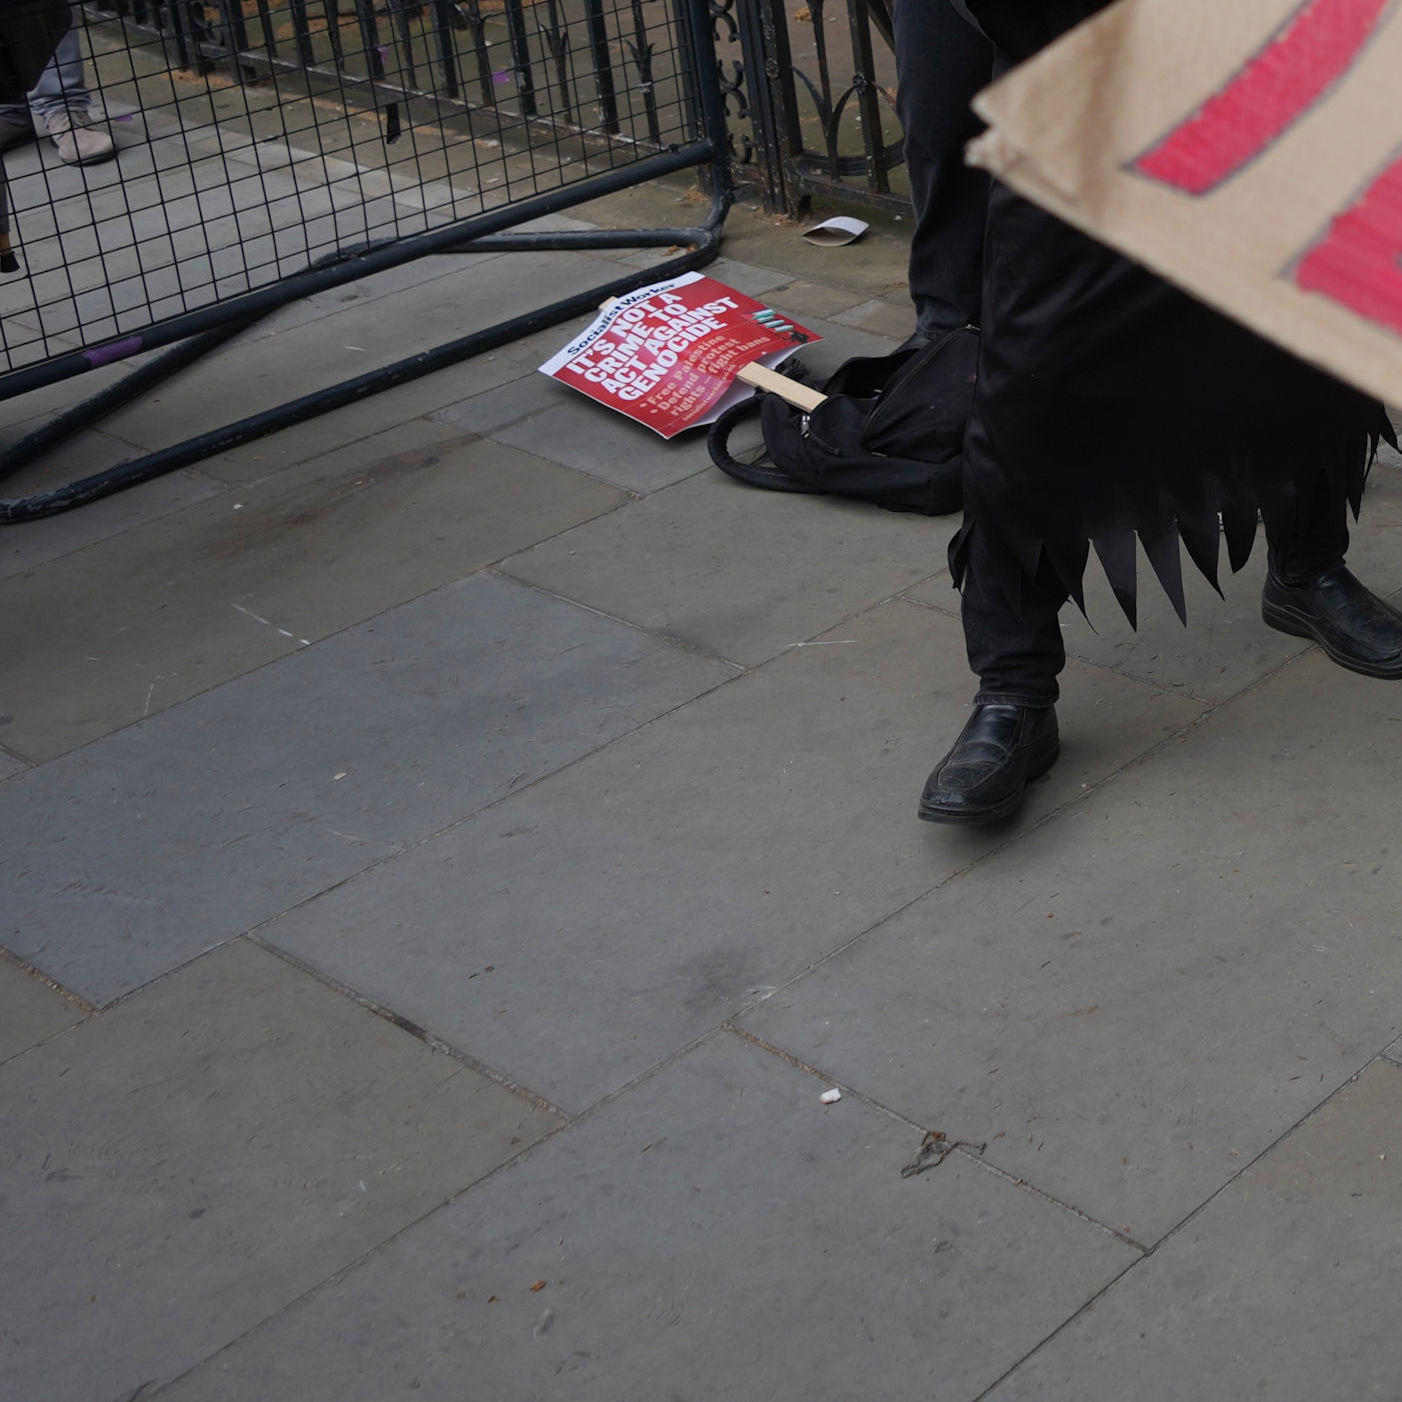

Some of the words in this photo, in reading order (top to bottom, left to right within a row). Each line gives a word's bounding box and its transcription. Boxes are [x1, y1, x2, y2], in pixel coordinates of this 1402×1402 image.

[566, 338, 616, 375] IT'S
[610, 300, 658, 338] NOT
[658, 292, 683, 305] A
[584, 321, 655, 383] CRIME
[650, 303, 688, 322] TO
[600, 355, 648, 394] ACT
[644, 296, 739, 356] AGAINST
[617, 316, 728, 400] GENOCIDE
[646, 382, 676, 405] Free
[674, 335, 726, 381] Palestine
[657, 373, 700, 410] Defend
[697, 338, 741, 374] protest
[670, 385, 706, 416] rights
[708, 350, 737, 374] fight
[736, 336, 771, 352] bans
